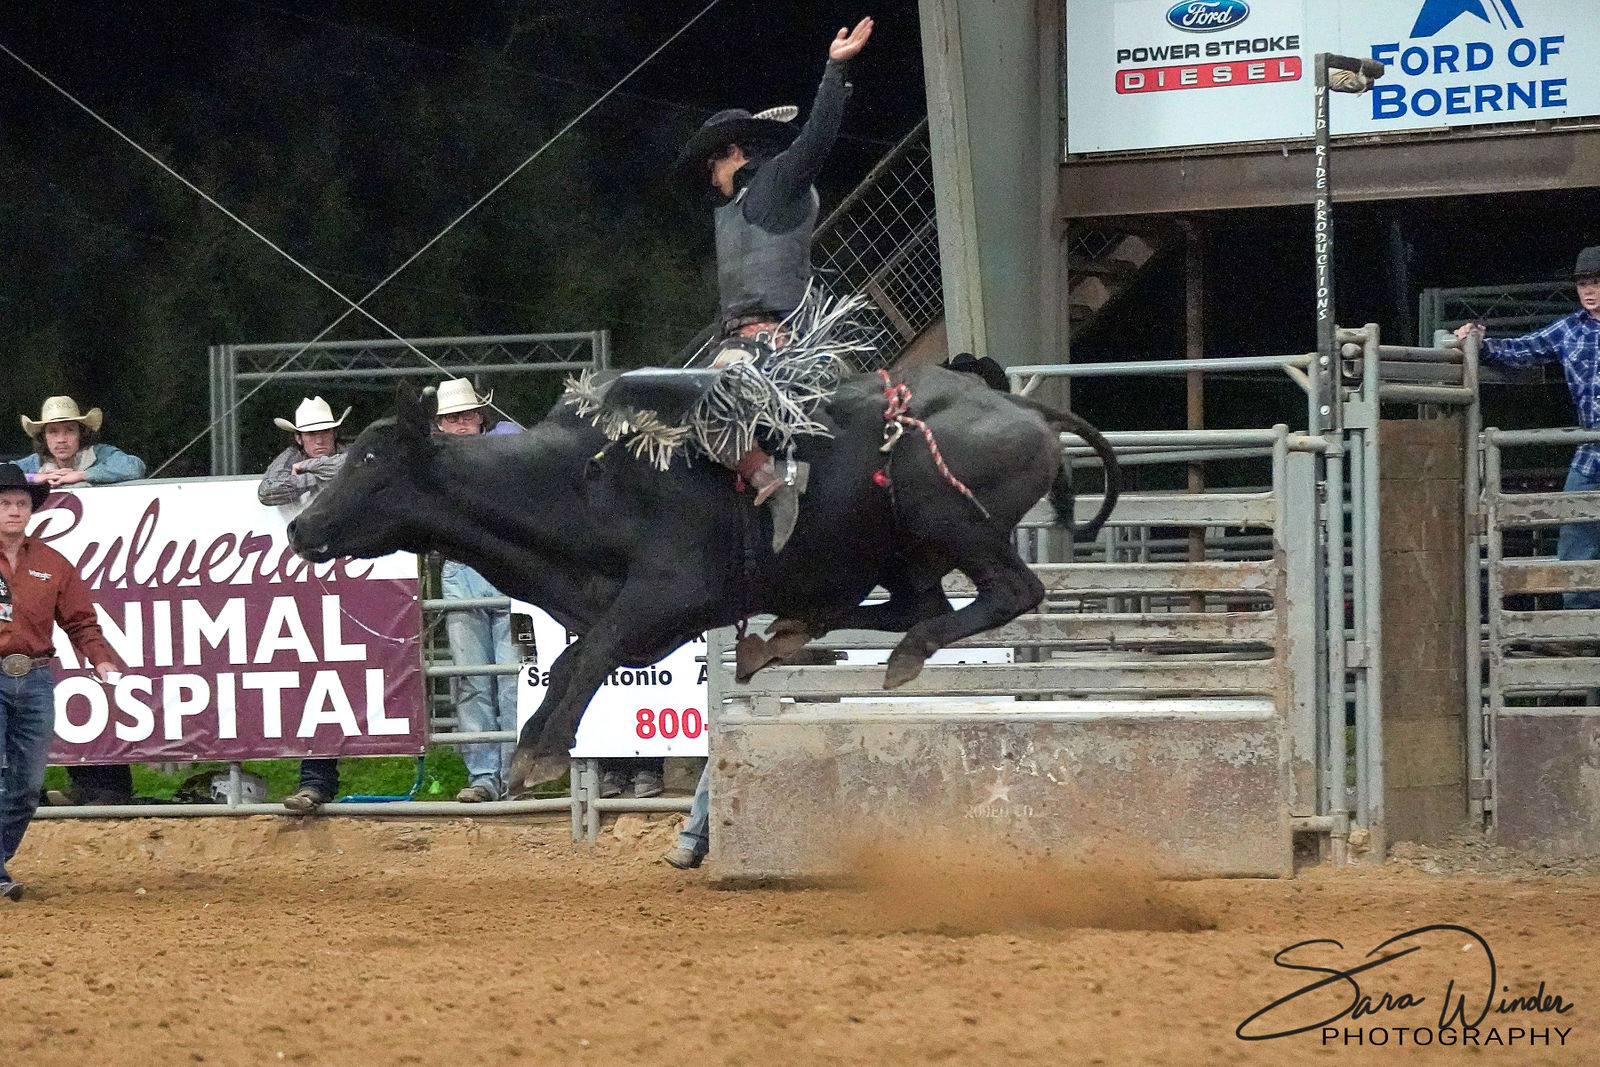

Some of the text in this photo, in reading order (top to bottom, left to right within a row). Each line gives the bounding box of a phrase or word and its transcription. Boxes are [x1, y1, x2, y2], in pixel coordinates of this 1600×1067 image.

[1182, 1, 1232, 26] Ford
[1117, 35, 1300, 64] POWER STROKE
[1370, 35, 1565, 76] FORD OF
[1124, 61, 1295, 90] DIESEL
[1371, 78, 1567, 120] BOERNE
[1314, 86, 1329, 321] WILD RIDE PRODUCTIONS
[603, 665, 673, 686] tonio
[53, 668, 410, 744] OSPITAL
